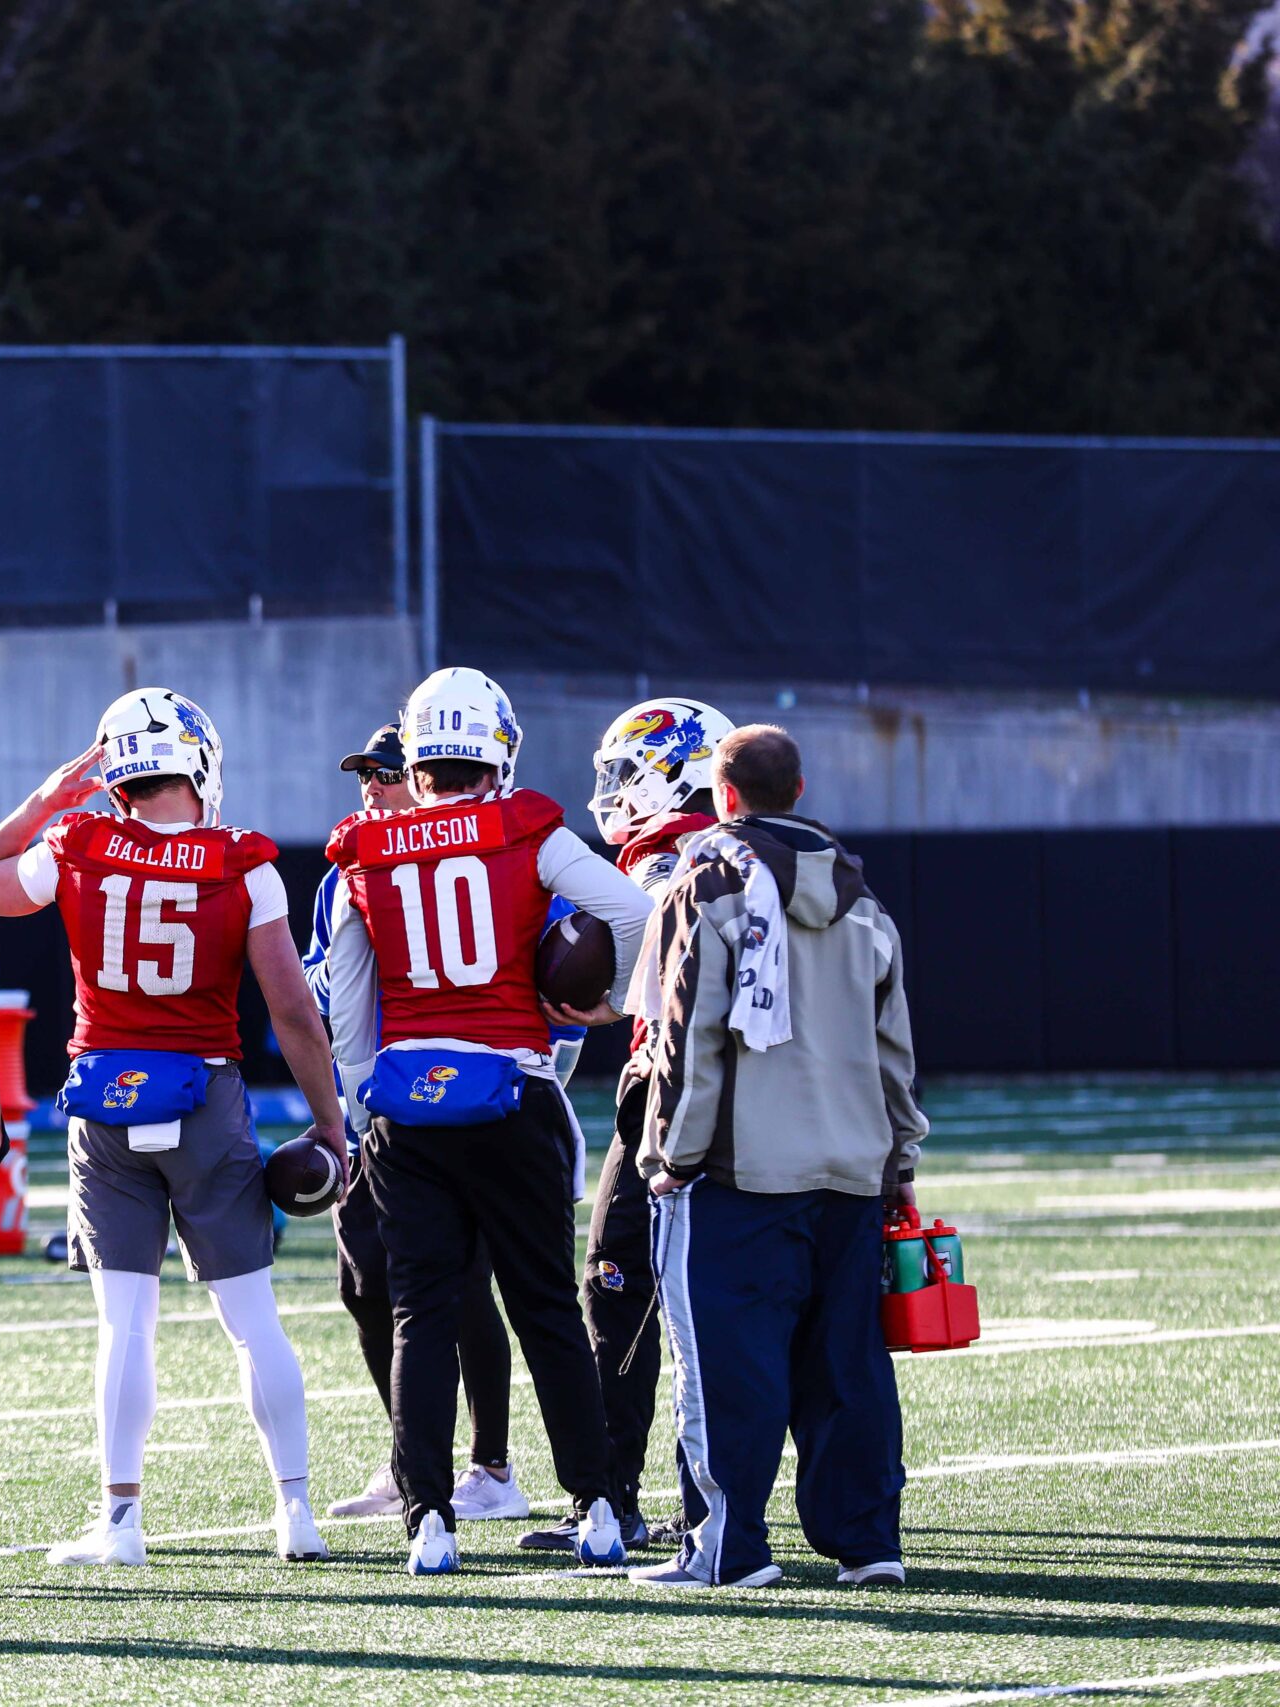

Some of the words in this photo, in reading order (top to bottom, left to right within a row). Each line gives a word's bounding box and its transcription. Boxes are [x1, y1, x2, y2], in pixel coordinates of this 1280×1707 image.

[439, 710, 462, 731] 10
[117, 735, 139, 757] 15
[445, 744, 483, 758] CHALK
[125, 760, 160, 774] CHALK
[381, 814, 479, 856] JACKSON
[105, 834, 206, 870] BALLARD
[391, 855, 498, 989] 10
[97, 873, 198, 996] 15
[115, 1089, 126, 1097] KU
